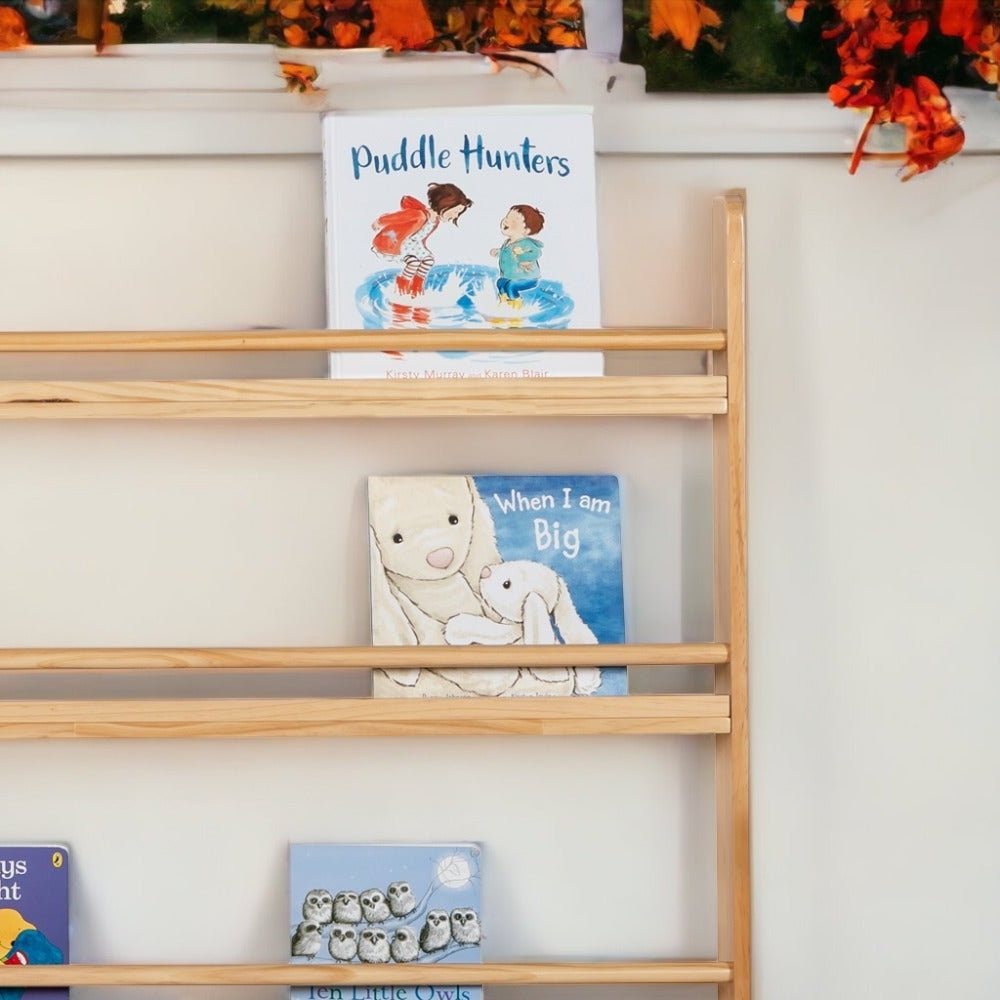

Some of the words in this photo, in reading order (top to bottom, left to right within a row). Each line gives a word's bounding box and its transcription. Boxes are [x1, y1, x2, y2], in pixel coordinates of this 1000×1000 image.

[351, 134, 451, 180] Puddle
[459, 134, 571, 178] Hunters
[424, 369, 465, 379] Murray
[484, 368, 517, 378] Karen
[522, 368, 550, 378] Blair
[493, 489, 555, 514] When
[562, 487, 572, 509] I
[579, 494, 611, 514] am
[534, 518, 580, 558] Big
